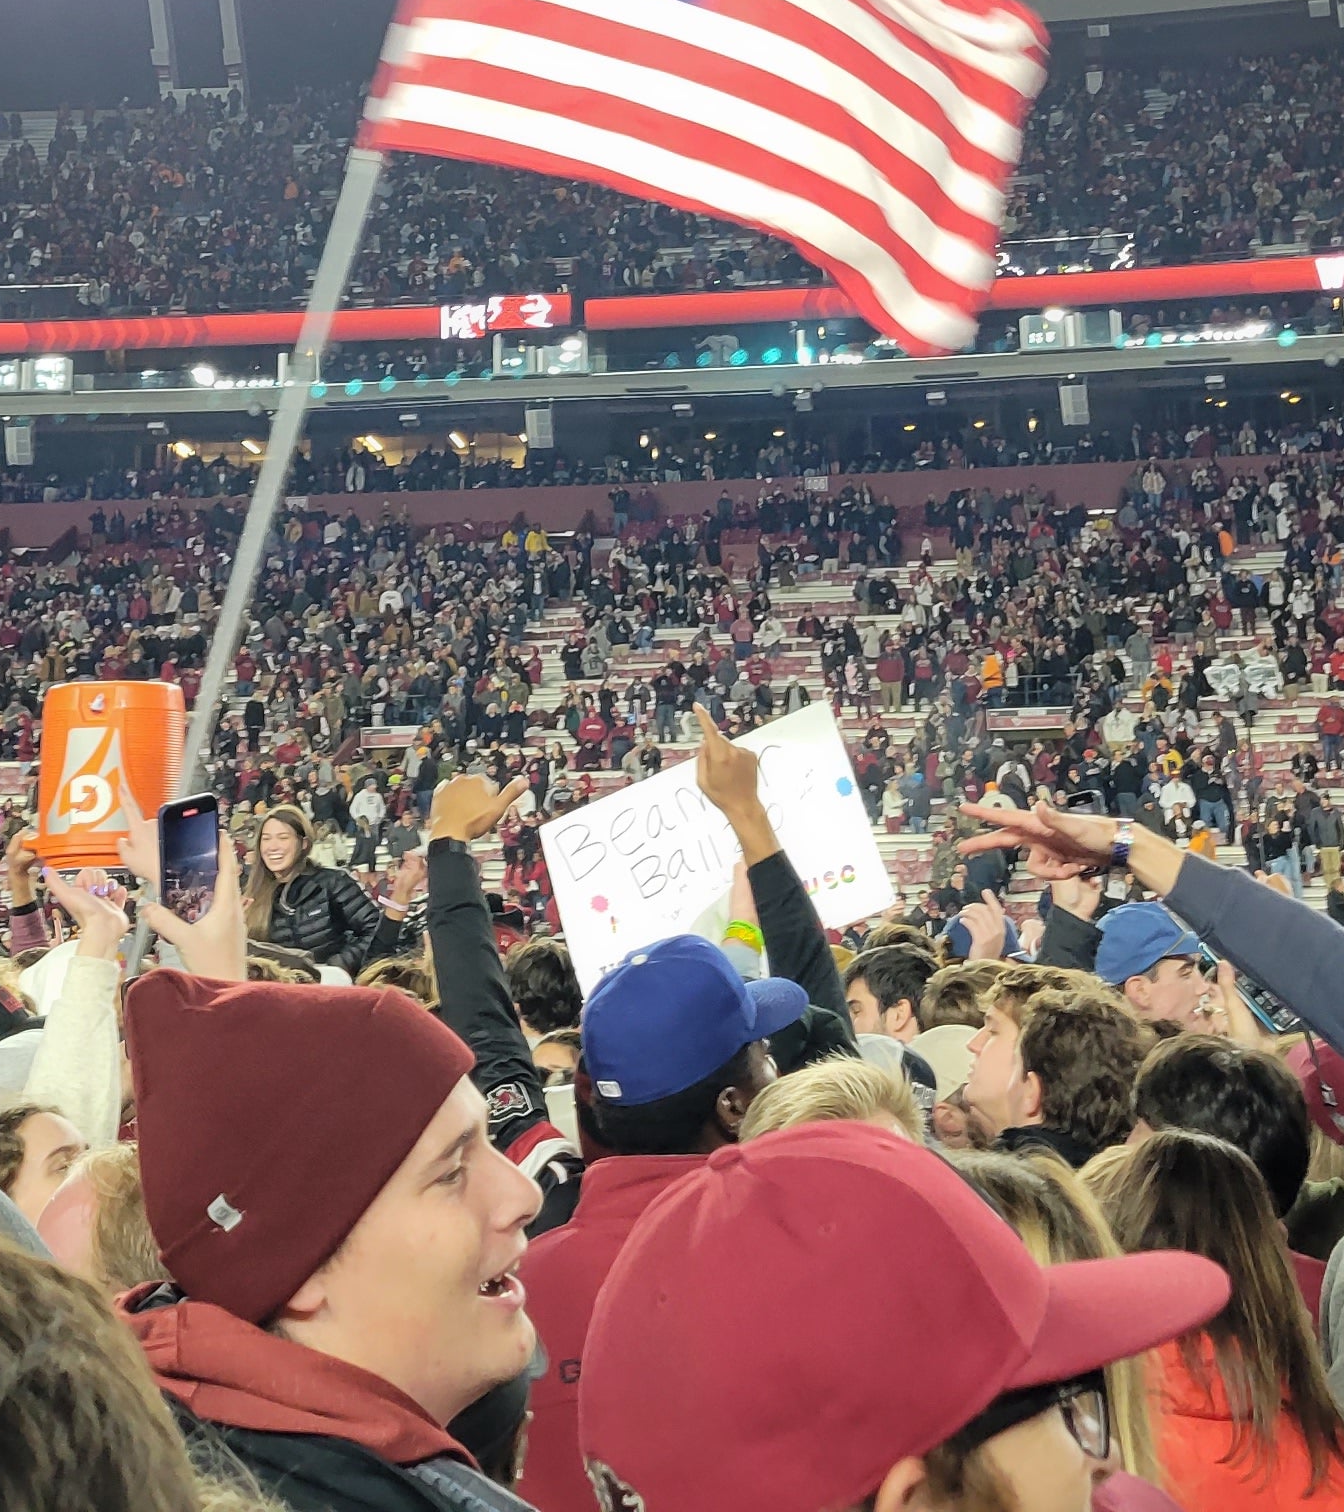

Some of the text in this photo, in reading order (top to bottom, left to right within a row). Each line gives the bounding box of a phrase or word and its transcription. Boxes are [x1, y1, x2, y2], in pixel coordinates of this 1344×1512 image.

[554, 744, 782, 882] Beamr
[630, 834, 723, 899] Ball
[803, 864, 856, 897] USC
